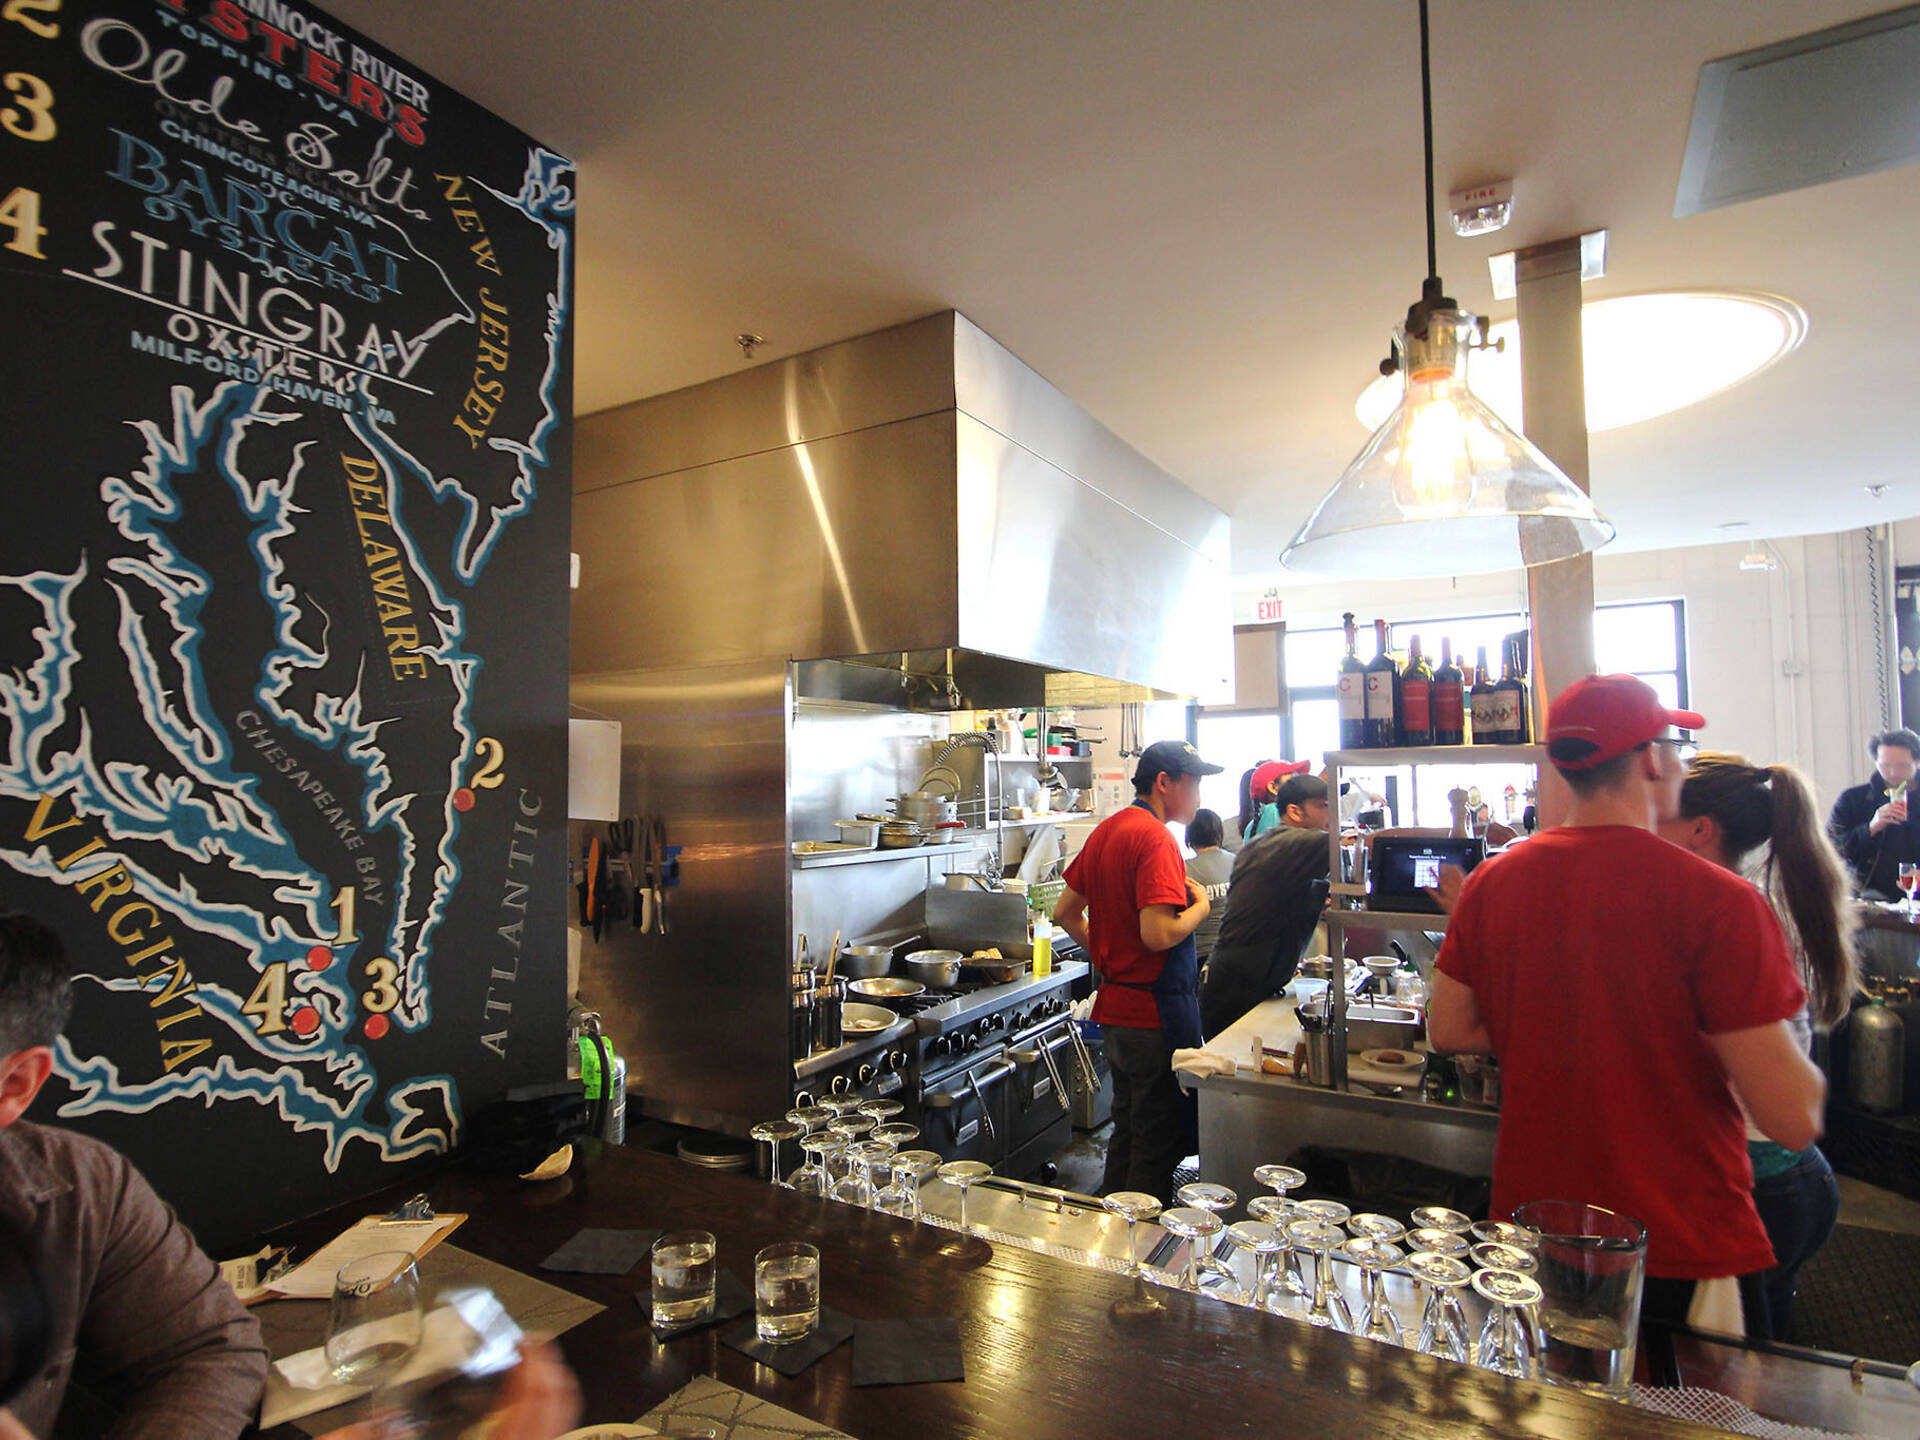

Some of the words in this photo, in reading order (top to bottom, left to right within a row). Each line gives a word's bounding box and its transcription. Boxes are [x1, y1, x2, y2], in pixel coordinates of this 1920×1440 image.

[0, 72, 58, 142] 3
[80, 18, 271, 143] Olde
[160, 0, 428, 146] STERS
[238, 0, 345, 62] NNOCK
[351, 44, 430, 113] RIVER
[0, 186, 48, 260] 4
[105, 127, 409, 294] BARCAT
[433, 172, 502, 277] NEW
[1464, 188, 1496, 201] FIRE
[92, 221, 429, 379] STINGRAY
[130, 330, 260, 384] MILFORD
[453, 287, 510, 450] JERSEY
[340, 451, 428, 681] DELAWARE
[1258, 600, 1282, 620] EXIT
[236, 710, 366, 850] CHESAPEAKE
[355, 856, 384, 906] BAY
[471, 738, 505, 789] 2
[24, 792, 213, 1073] VIRGINIA
[330, 886, 360, 946] 1
[480, 787, 543, 1060] ATLANTIC
[242, 962, 289, 1035] 4
[362, 957, 400, 1013] 3
